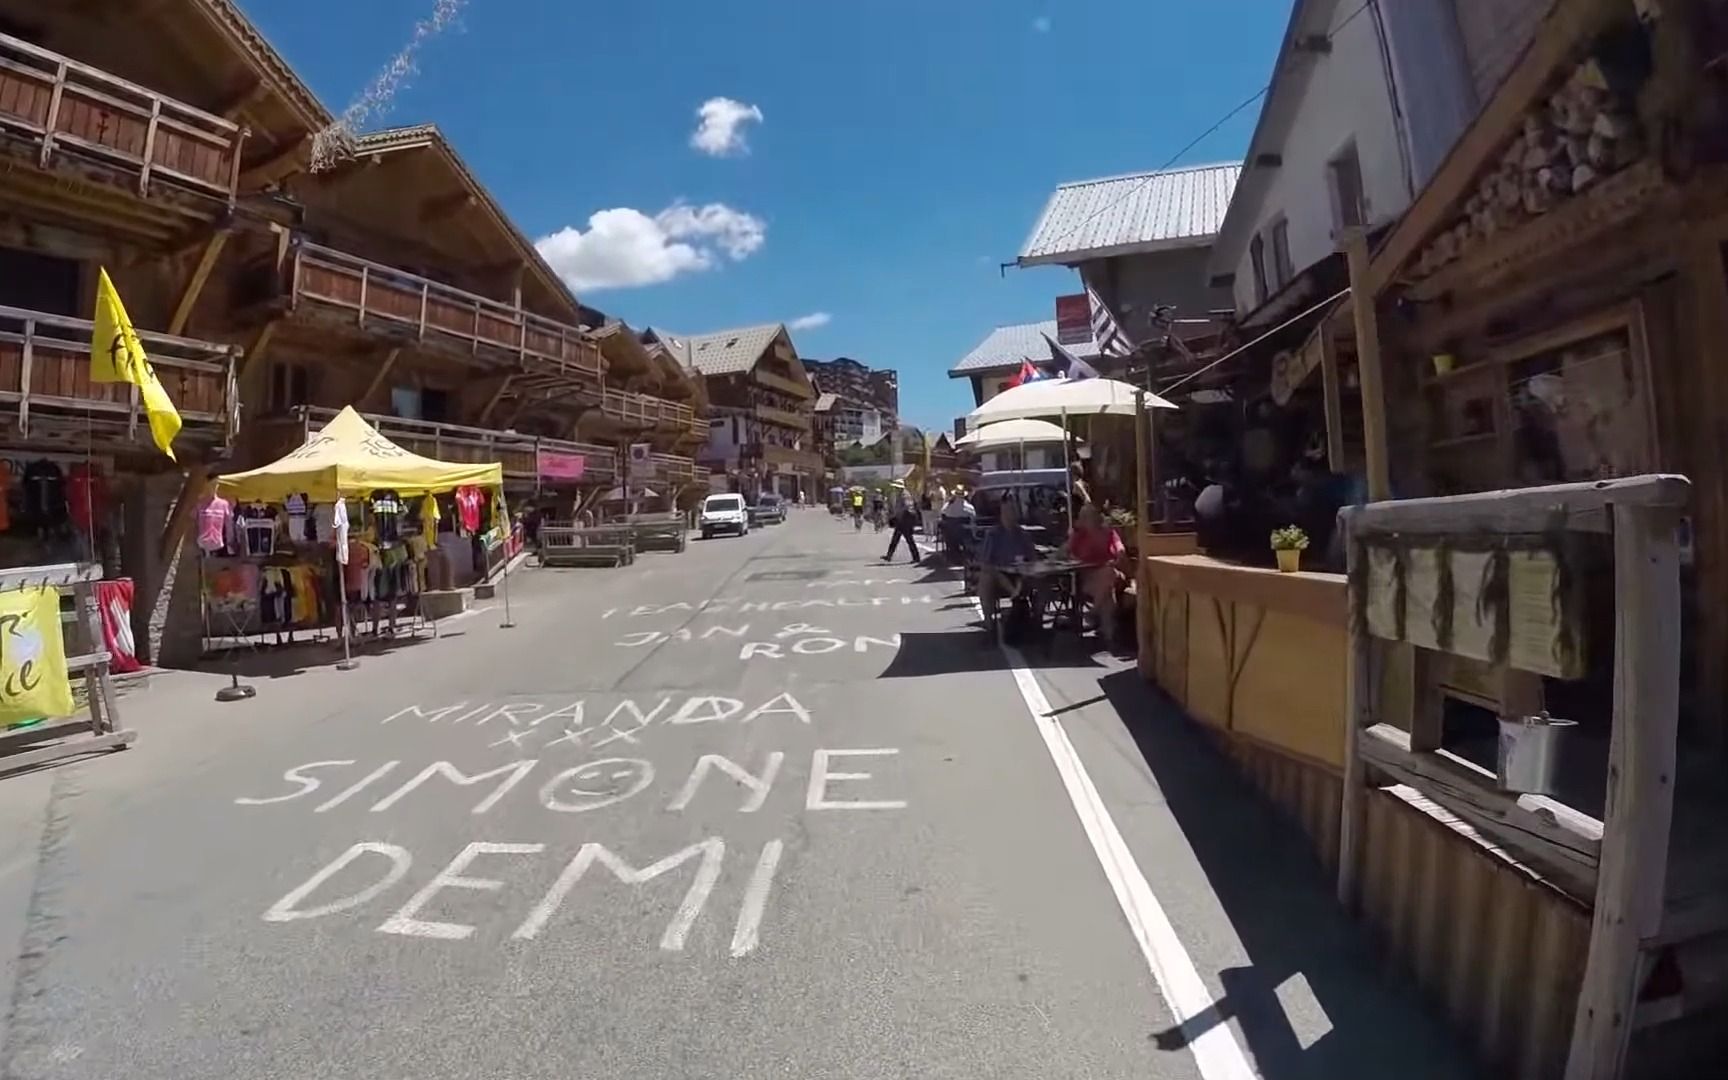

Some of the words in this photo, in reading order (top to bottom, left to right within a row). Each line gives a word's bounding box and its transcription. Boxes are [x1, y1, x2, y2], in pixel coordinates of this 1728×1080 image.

[615, 624, 749, 646] JAN
[774, 622, 830, 639] &
[739, 633, 902, 661] RON
[380, 691, 815, 726] MIRANDA
[234, 747, 908, 814] SIMONE
[262, 836, 784, 957] DEMI
